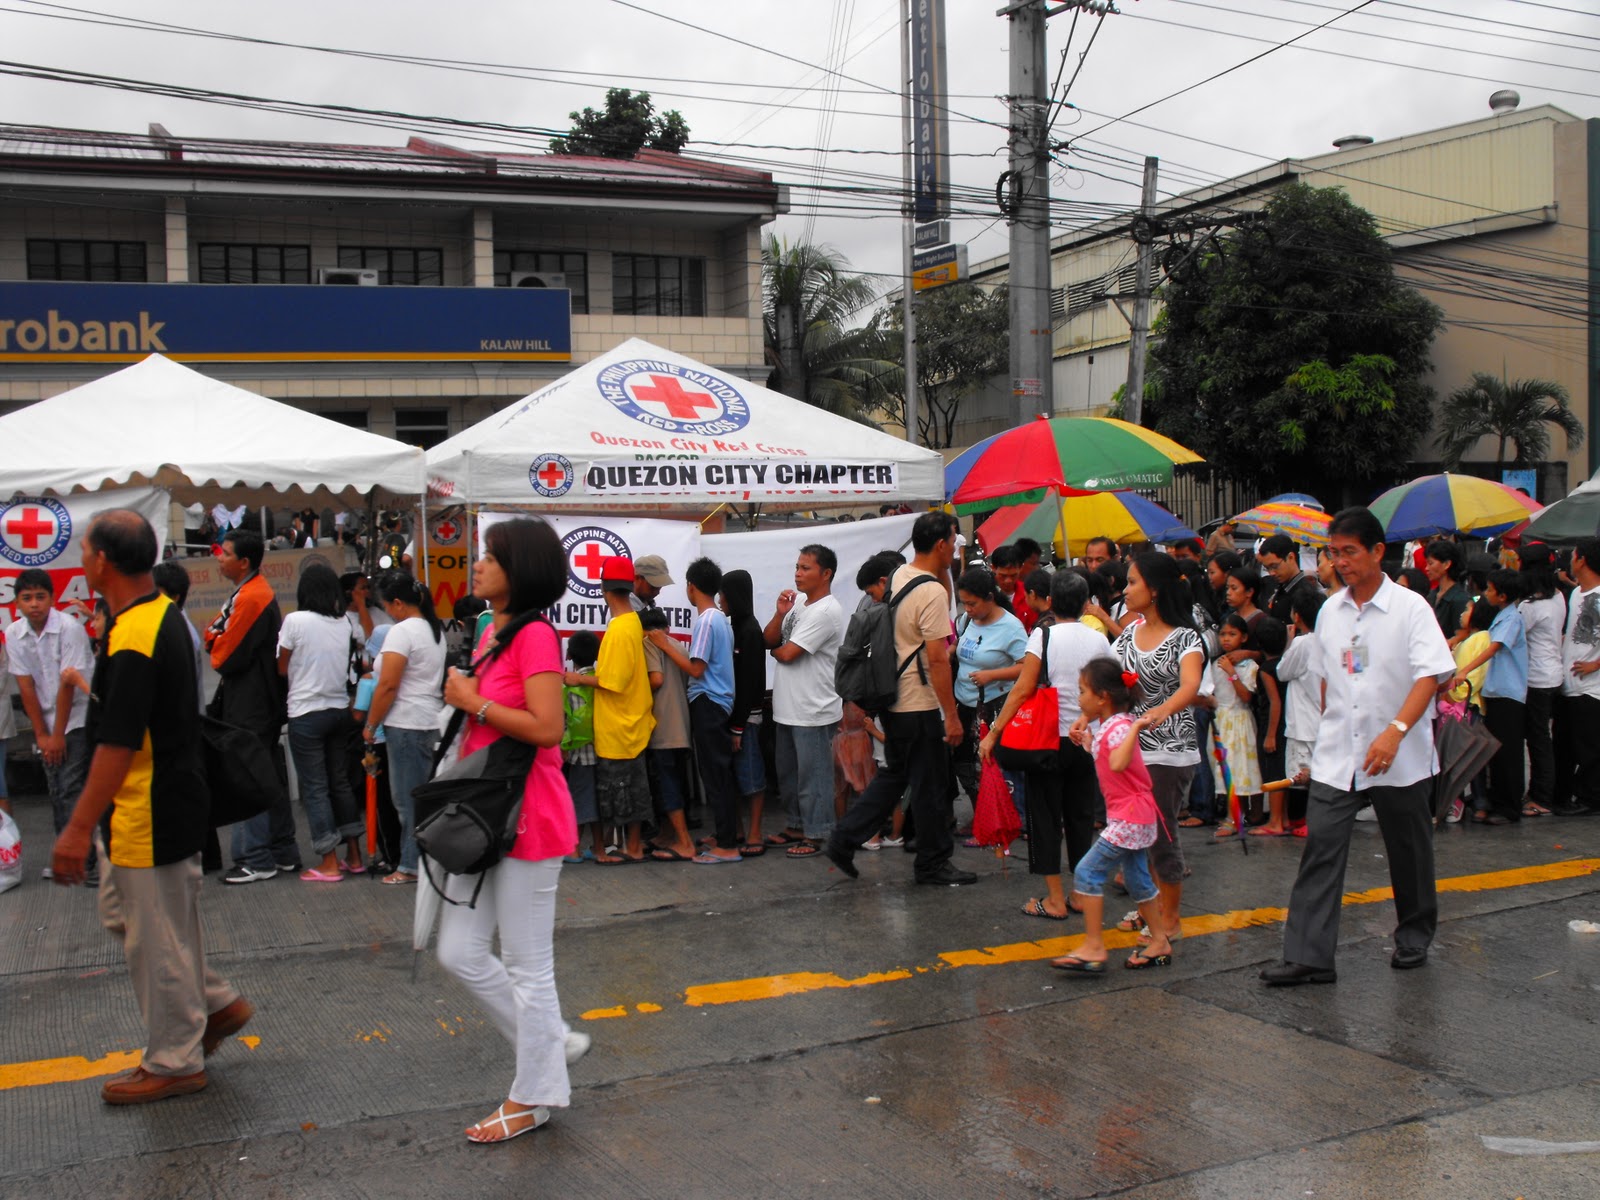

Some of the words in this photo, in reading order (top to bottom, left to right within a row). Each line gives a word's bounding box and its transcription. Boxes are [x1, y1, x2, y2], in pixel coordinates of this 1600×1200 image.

[480, 339, 523, 350] KALAW
[525, 339, 552, 350] HILL
[600, 359, 681, 386] PHILIPPINE
[600, 383, 631, 407] THE
[684, 370, 748, 416] NATIONAL
[682, 419, 739, 436] CROSS
[590, 431, 665, 450] Quezon
[670, 437, 709, 453] City
[755, 442, 808, 456] Cross
[587, 465, 698, 490] QUEZON
[704, 464, 768, 486] CITY
[775, 464, 893, 485] CHAPTER
[45, 499, 70, 541] NATIONAL
[1, 546, 21, 562] RED
[24, 547, 59, 565] CROSS
[562, 529, 606, 551] HILIPPINE
[606, 535, 629, 559] NATIO
[567, 579, 586, 595] RED
[566, 604, 609, 625] CITY
